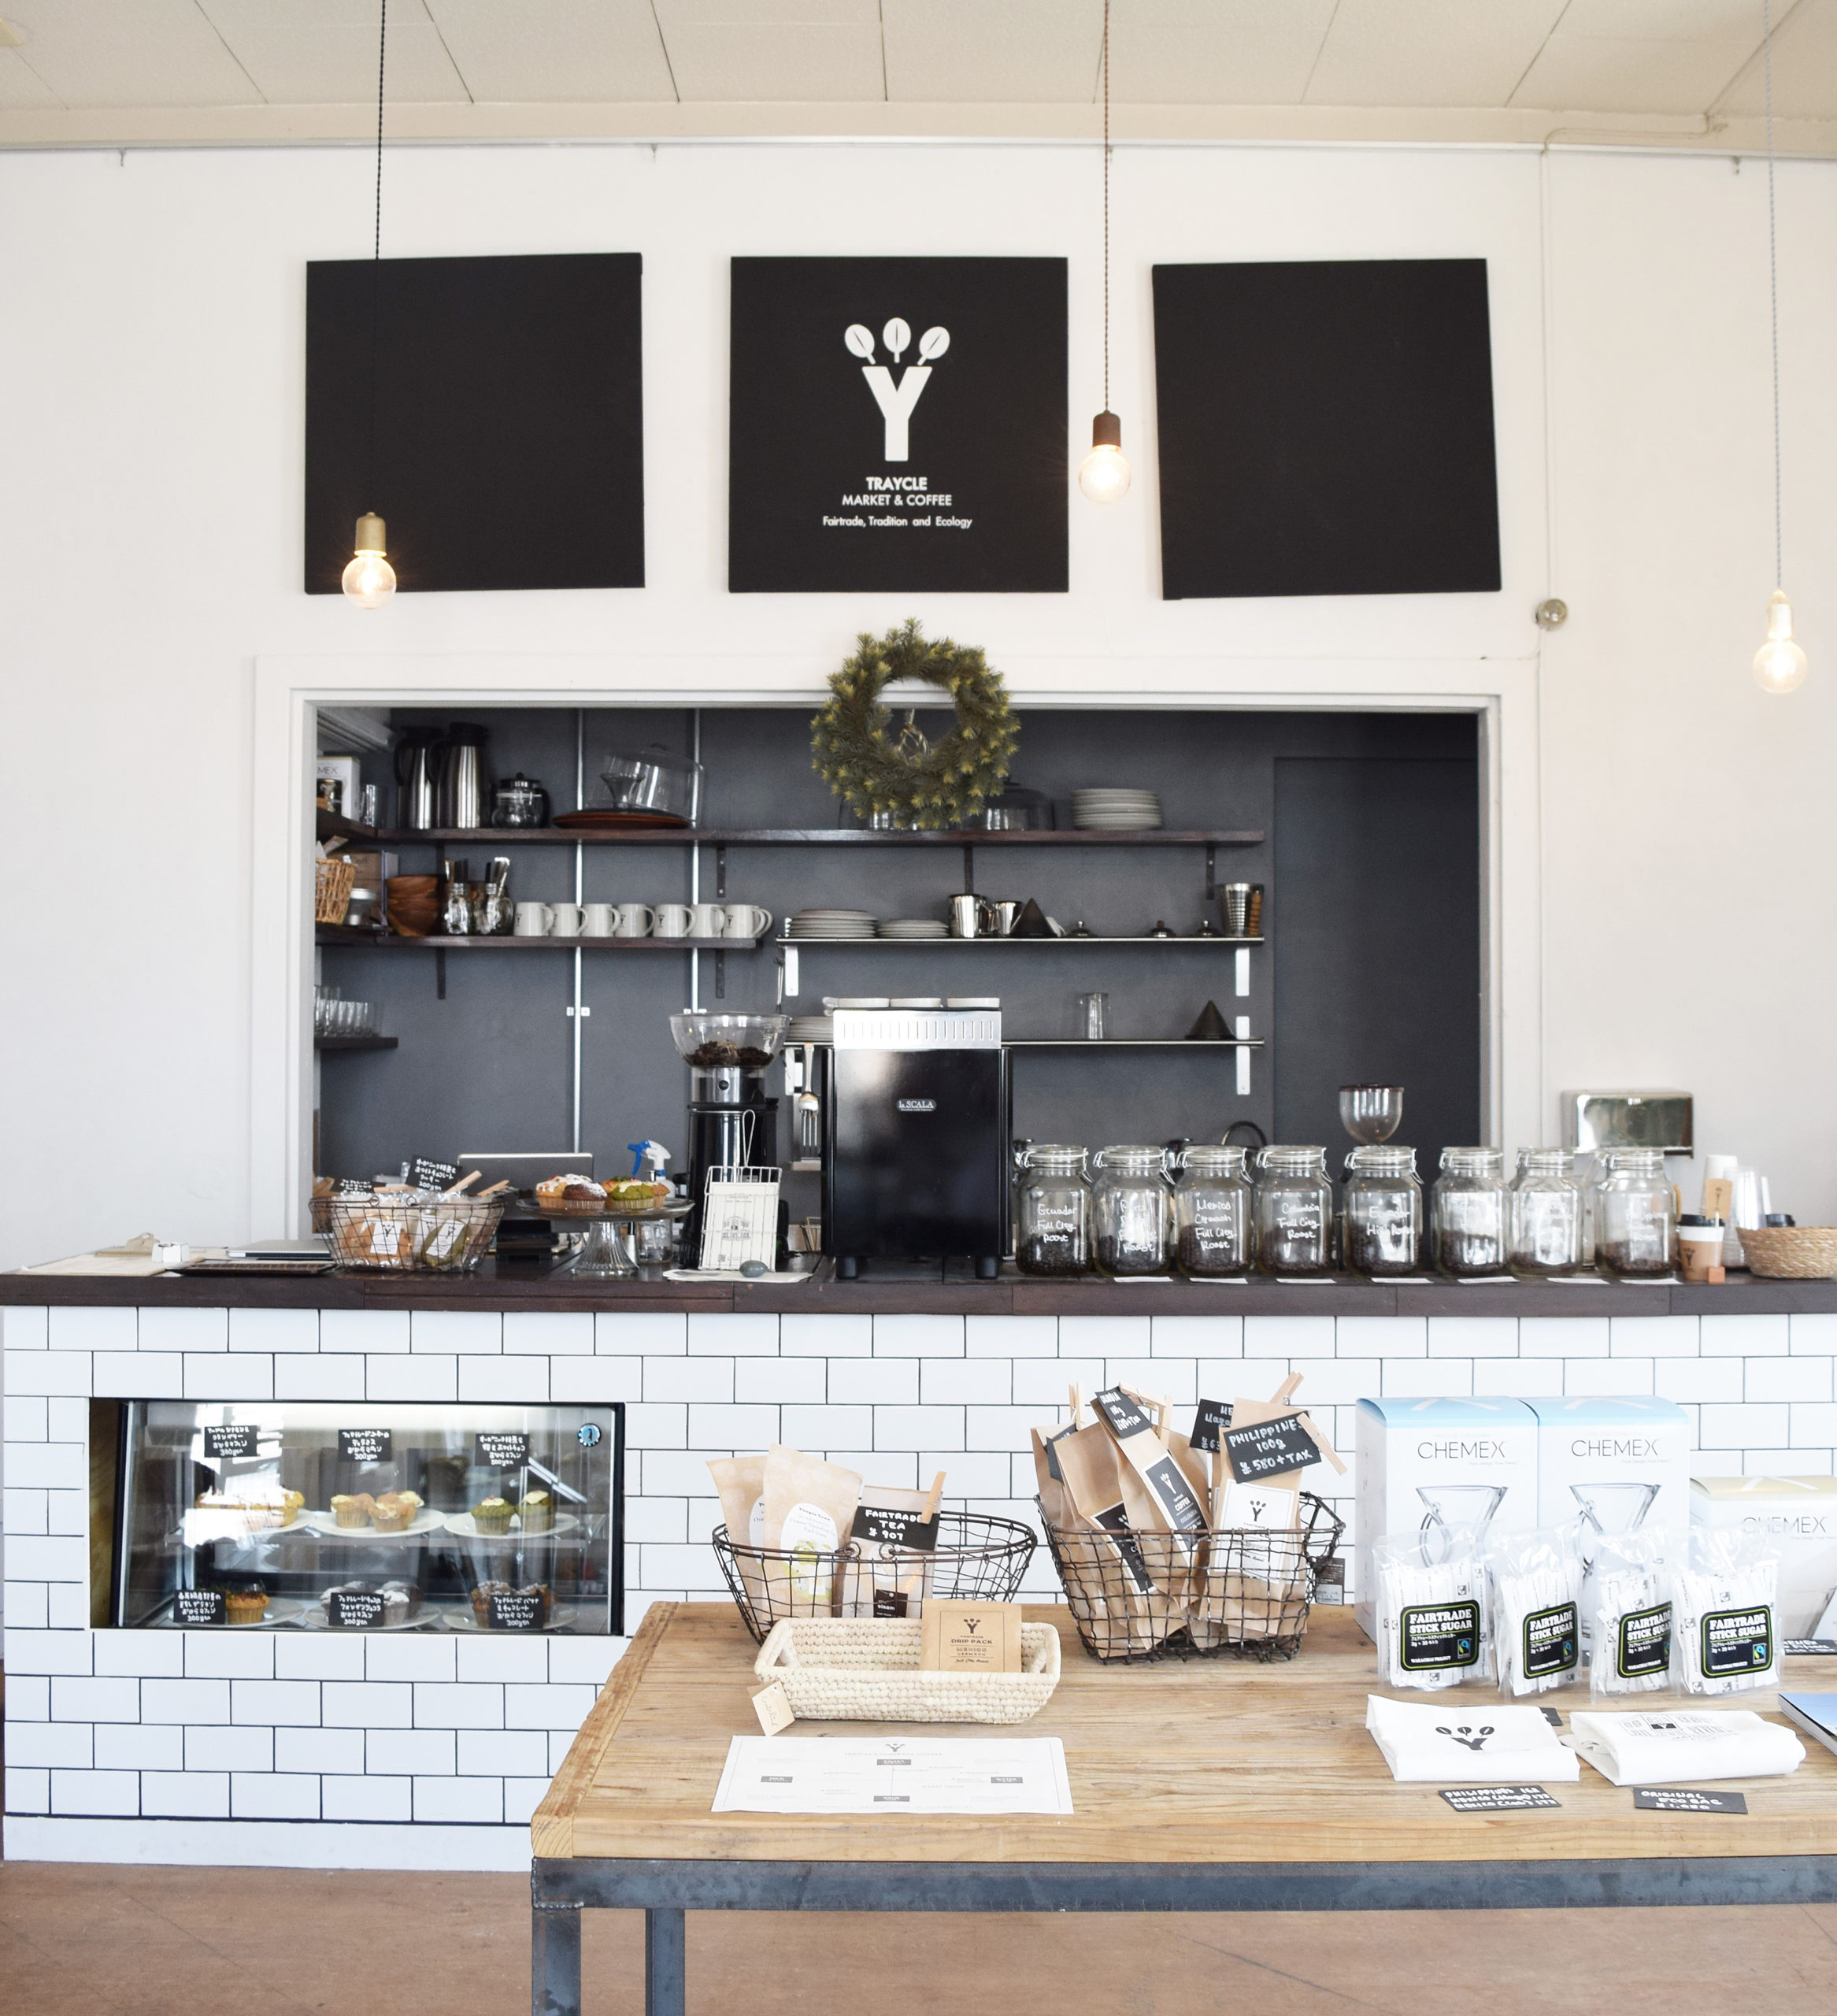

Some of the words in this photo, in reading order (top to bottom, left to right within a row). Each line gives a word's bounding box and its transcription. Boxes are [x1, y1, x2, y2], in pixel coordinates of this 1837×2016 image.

[866, 477, 928, 491] TRAYCLE
[842, 495, 891, 506] MARKET
[894, 495, 903, 506] &
[906, 495, 952, 506] COFFEE
[823, 516, 866, 527] Fairtrade,
[869, 515, 908, 526] Tradition
[913, 516, 931, 526] and
[935, 516, 972, 528] Ecology
[1038, 1204, 1077, 1215] Ecuador
[1197, 1199, 1231, 1211] Mexico
[1037, 1220, 1053, 1230] Full
[1276, 1217, 1298, 1228] Full
[1195, 1228, 1214, 1240] Full
[1287, 1229, 1316, 1240] Roast
[1201, 1241, 1230, 1251] Roast
[1256, 1438, 1287, 1453] 100g
[1417, 1441, 1506, 1458] CHEMEX
[1572, 1439, 1659, 1457] CHEMEX
[1174, 1497, 1191, 1511] COFFEE
[879, 1520, 906, 1529] TEA
[869, 1527, 878, 1537] ¥
[882, 1530, 904, 1541] 907
[1409, 1609, 1472, 1624] FAIRTRADE
[1530, 1610, 1572, 1631] FAIRTRADE
[1709, 1613, 1766, 1630] FAIRTRADE
[506, 1619, 530, 1628] 300yen
[1409, 1623, 1439, 1633] STICK
[1441, 1620, 1472, 1631] SUGAR
[1530, 1628, 1552, 1641] STICK
[1552, 1621, 1573, 1635] SUGAR
[1627, 1628, 1652, 1640] STICK
[1652, 1622, 1669, 1636] SUGA
[1709, 1629, 1738, 1640] STICK
[1738, 1625, 1767, 1636] SUGAR
[1641, 1791, 1706, 1799] ORIGINAL
